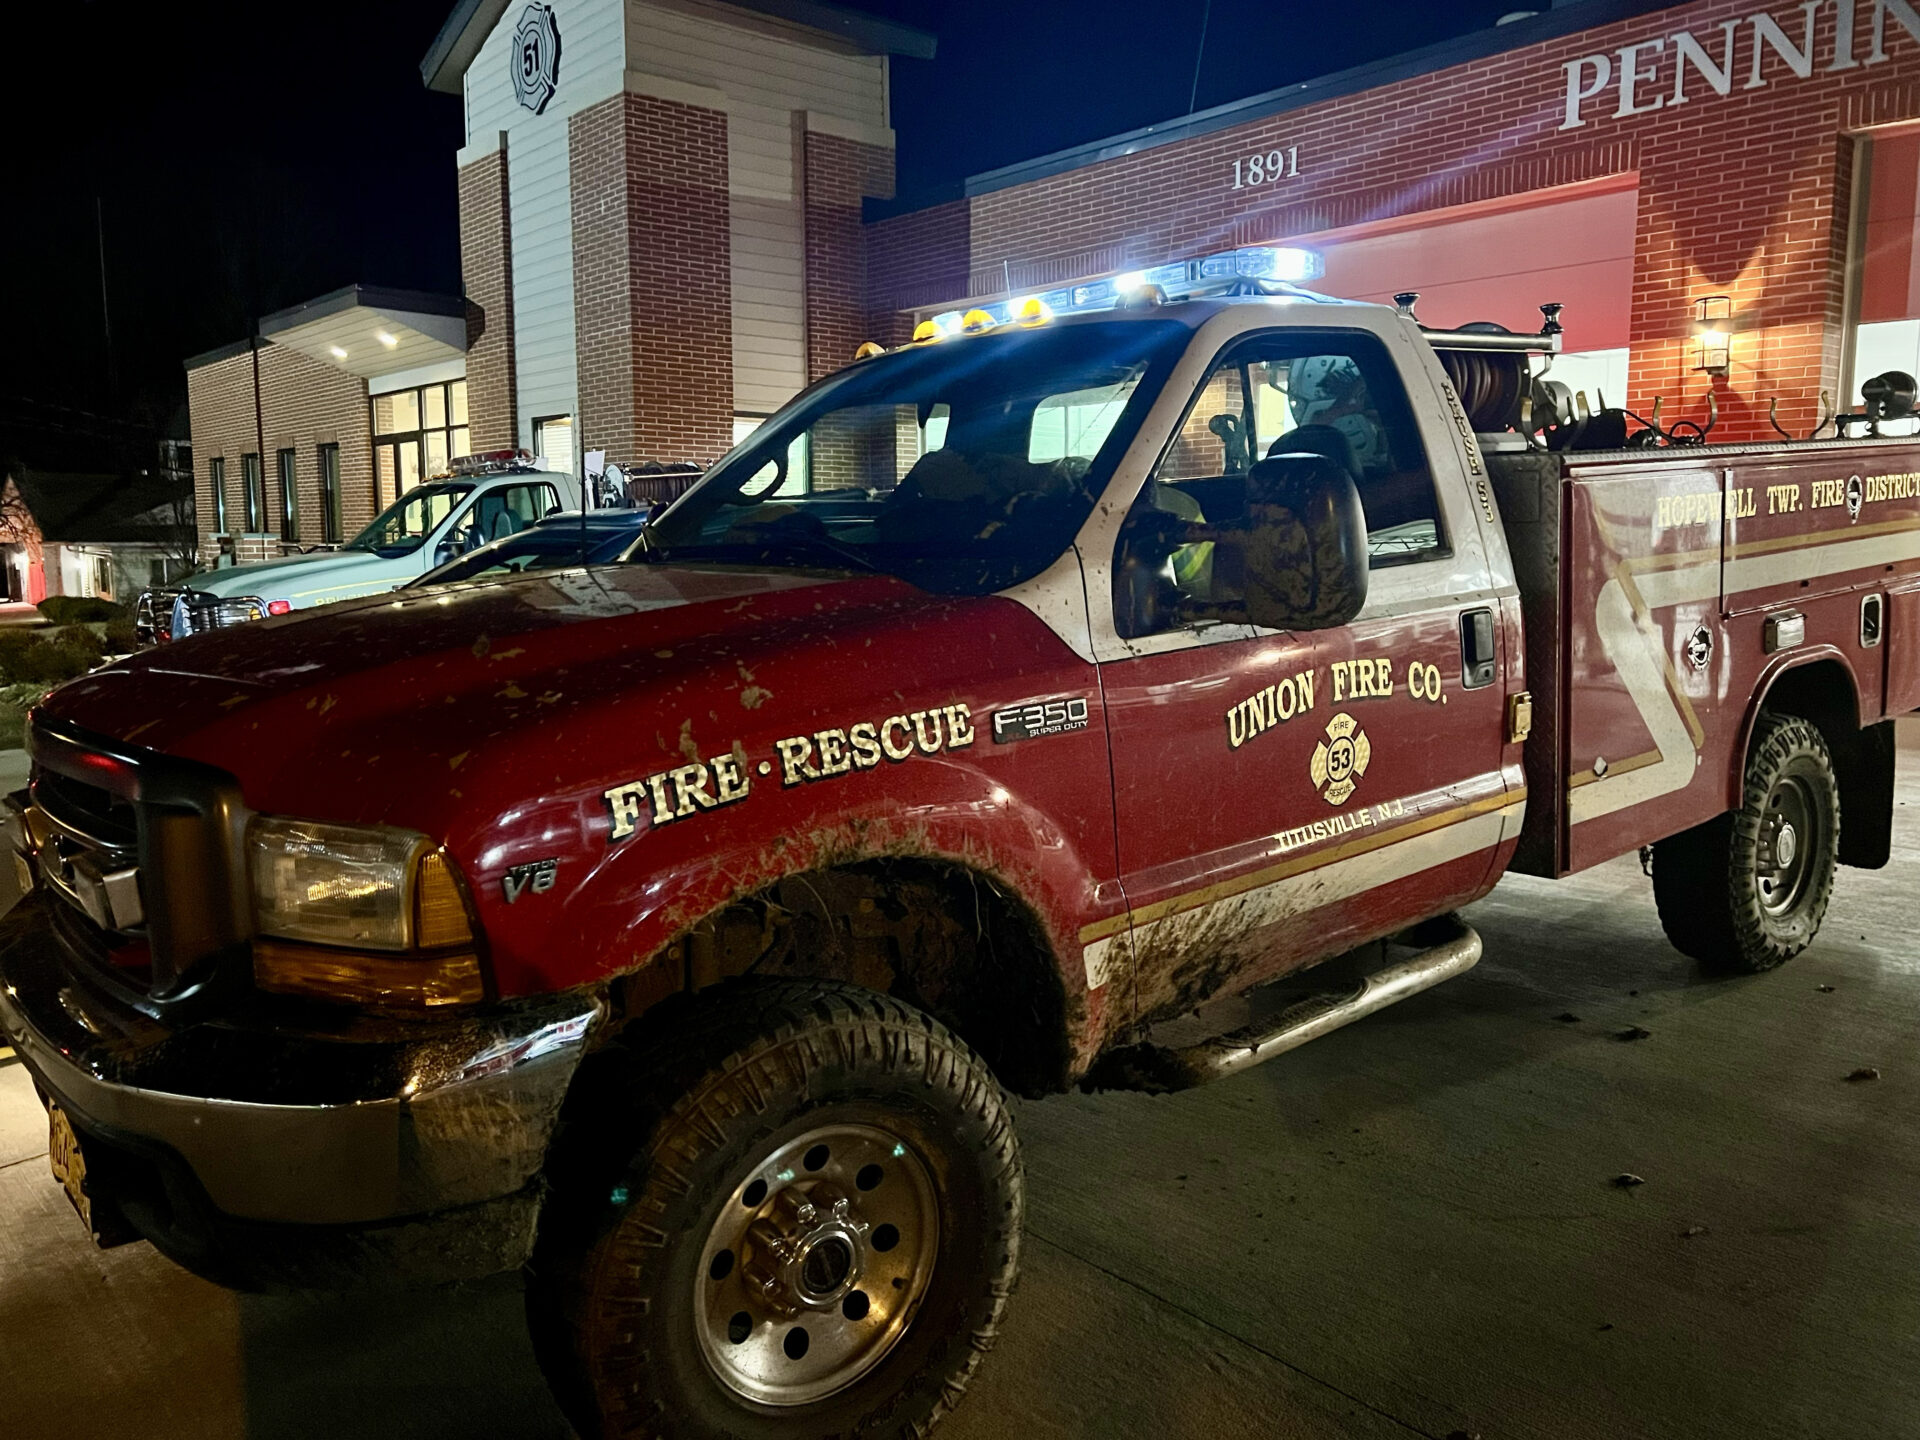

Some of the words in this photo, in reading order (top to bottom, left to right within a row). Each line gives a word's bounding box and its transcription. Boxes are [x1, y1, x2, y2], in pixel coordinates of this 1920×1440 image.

[523, 38, 540, 77] 51
[1231, 146, 1300, 190] 1891
[1657, 488, 1757, 528] HOPEWELL
[1766, 484, 1803, 515] TWP.
[1811, 479, 1845, 509] FIRE
[1227, 669, 1315, 748] UNION
[1331, 658, 1394, 702] FIRE
[1408, 661, 1448, 704] CO.
[1029, 725, 1062, 738] SUPER
[1064, 719, 1089, 731] DUTY
[1333, 720, 1350, 732] FIRE
[603, 752, 751, 840] FIRE
[776, 703, 977, 786] RESCUE
[1331, 747, 1351, 772] 53
[1329, 783, 1352, 798] RESCUE
[1274, 807, 1378, 849] TITUSVILLE,
[504, 868, 557, 904] V8
